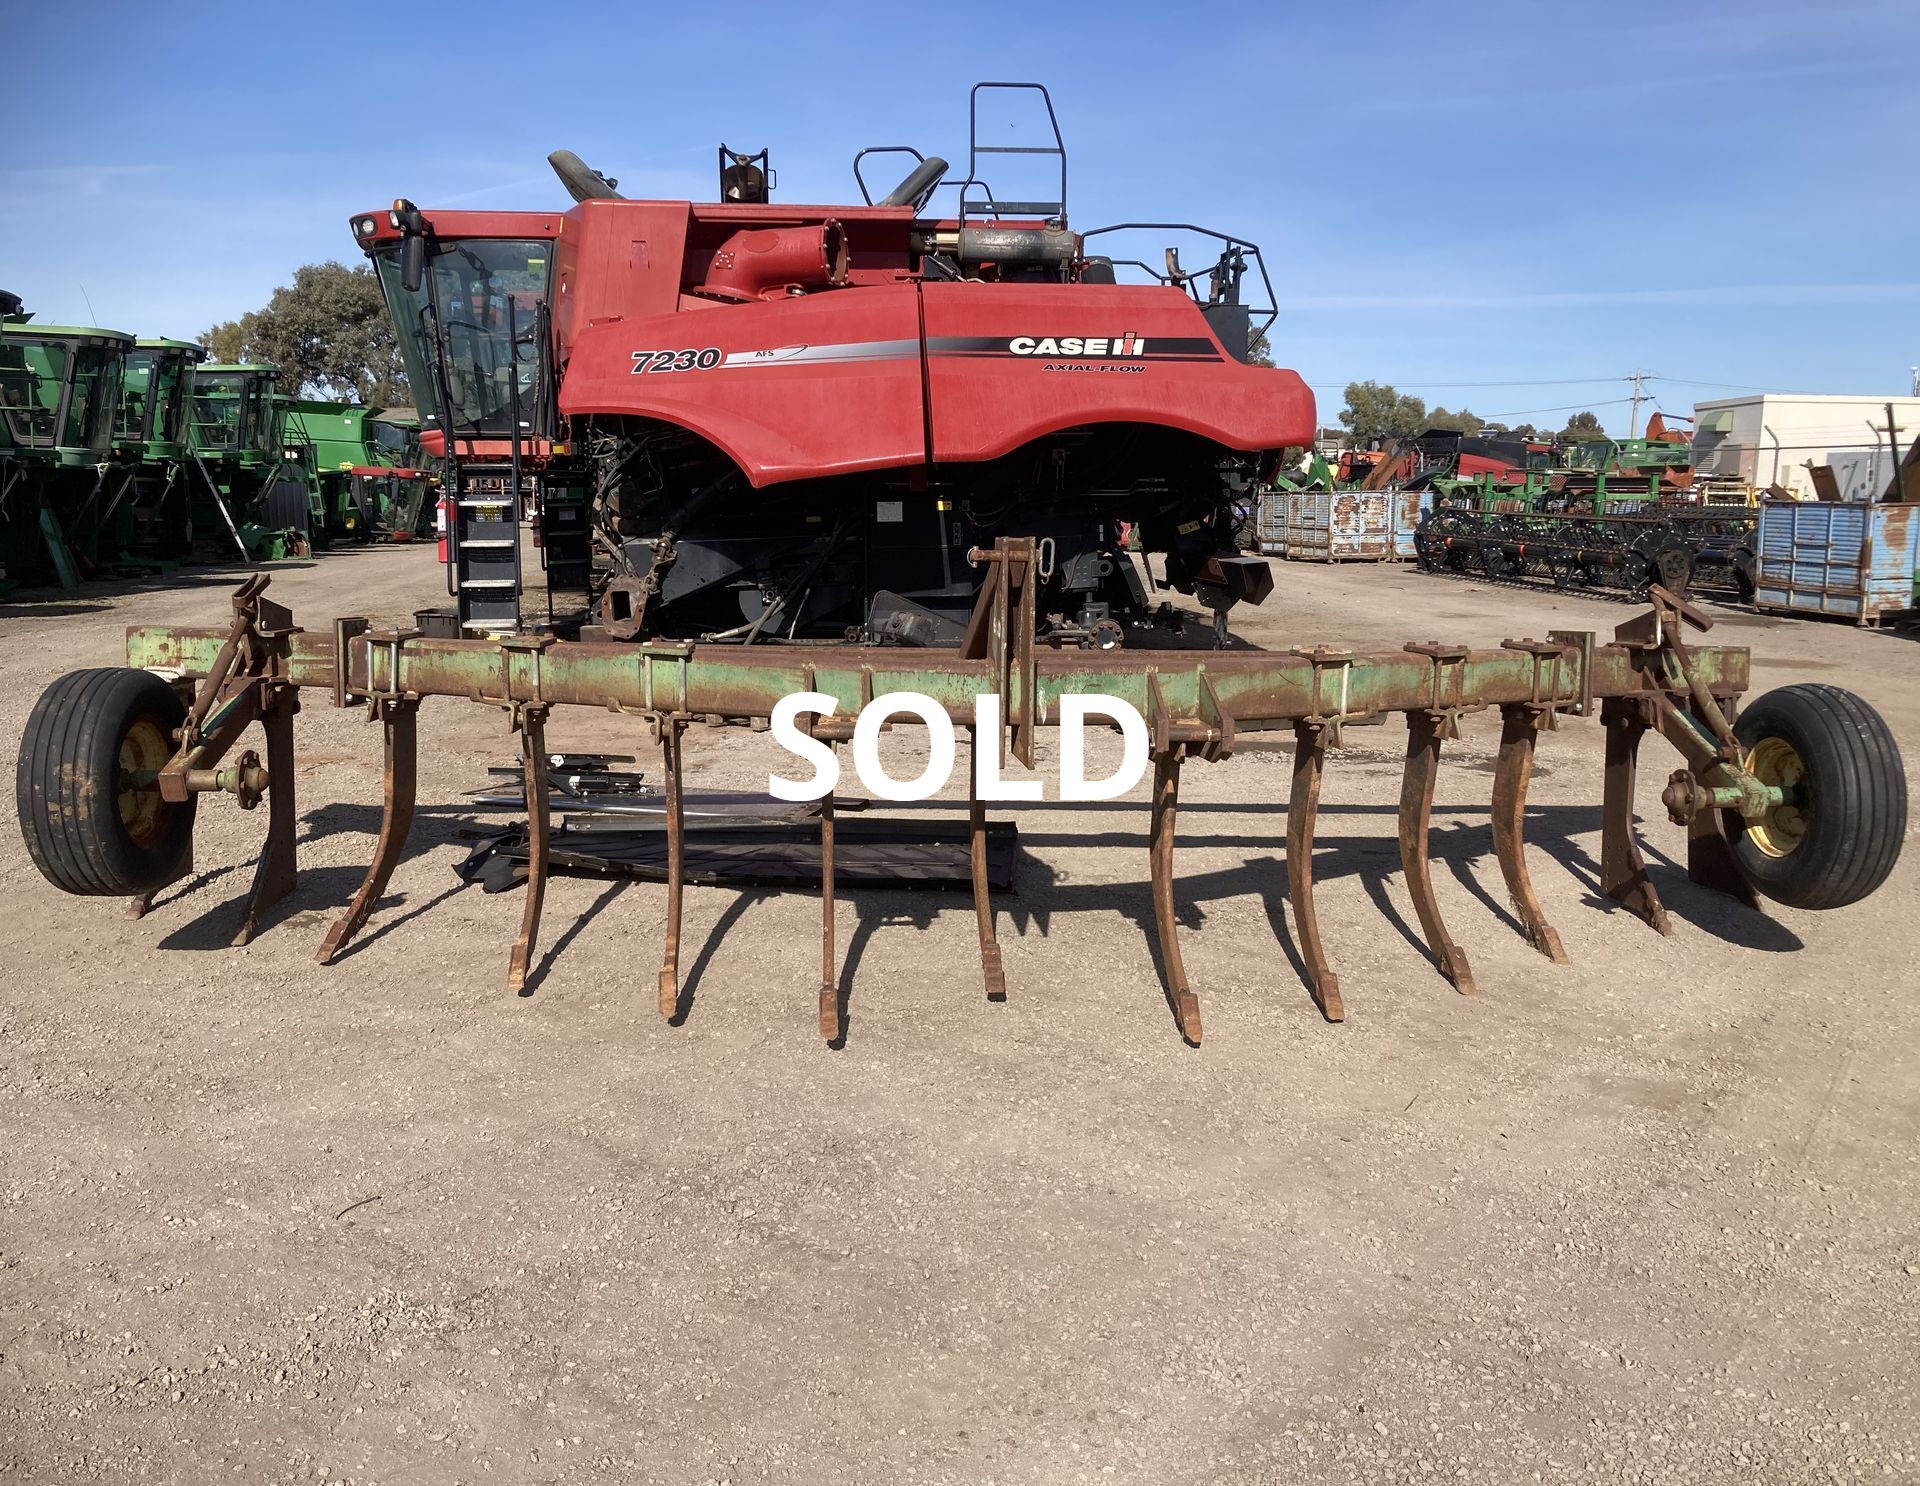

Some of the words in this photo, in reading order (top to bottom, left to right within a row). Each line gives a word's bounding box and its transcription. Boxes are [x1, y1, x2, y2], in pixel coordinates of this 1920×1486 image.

[755, 350, 775, 358] AFS
[1009, 337, 1109, 356] CASE
[631, 348, 722, 374] 7230
